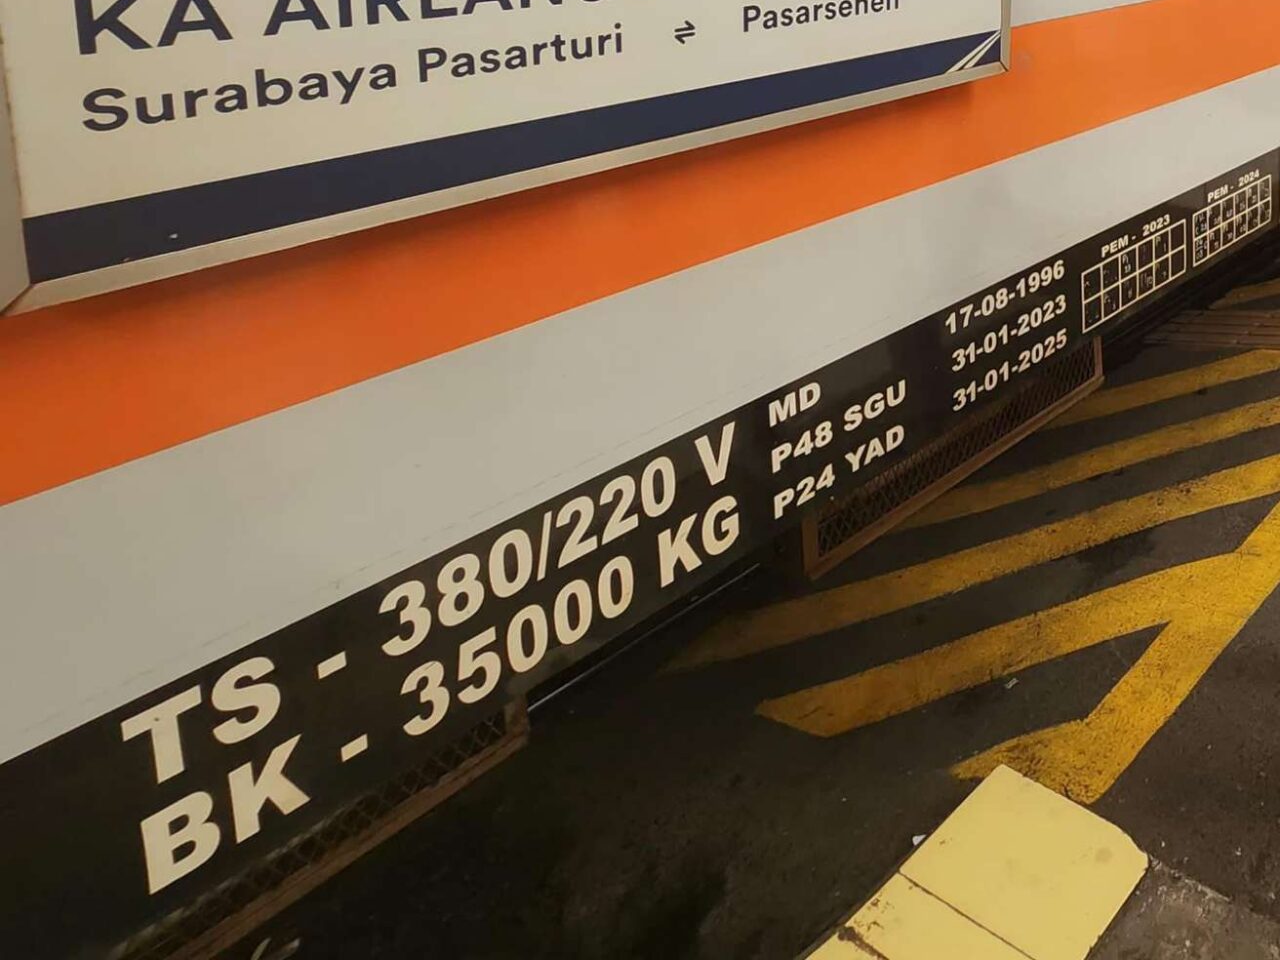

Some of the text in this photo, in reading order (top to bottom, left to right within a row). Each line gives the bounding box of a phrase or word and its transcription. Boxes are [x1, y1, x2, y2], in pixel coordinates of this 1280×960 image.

[82, 60, 397, 132] Surabaya
[417, 24, 624, 83] Pasarturi
[1207, 183, 1229, 203] PEM
[1238, 168, 1260, 188] 2024
[1101, 234, 1129, 258] PEM
[1142, 213, 1171, 237] 2023
[945, 259, 1065, 334] 17-08-1996
[951, 294, 1067, 372] 31-01-2023
[768, 382, 821, 427] MD
[952, 328, 1067, 412] 31-01-2025
[771, 379, 906, 474] P48 SGU
[773, 425, 905, 519] P24 YAD
[120, 656, 281, 784] TS
[378, 456, 676, 656] 380/220
[694, 421, 736, 486] V
[140, 734, 310, 895] BK
[400, 555, 634, 736] 35000
[657, 495, 740, 588] KG
